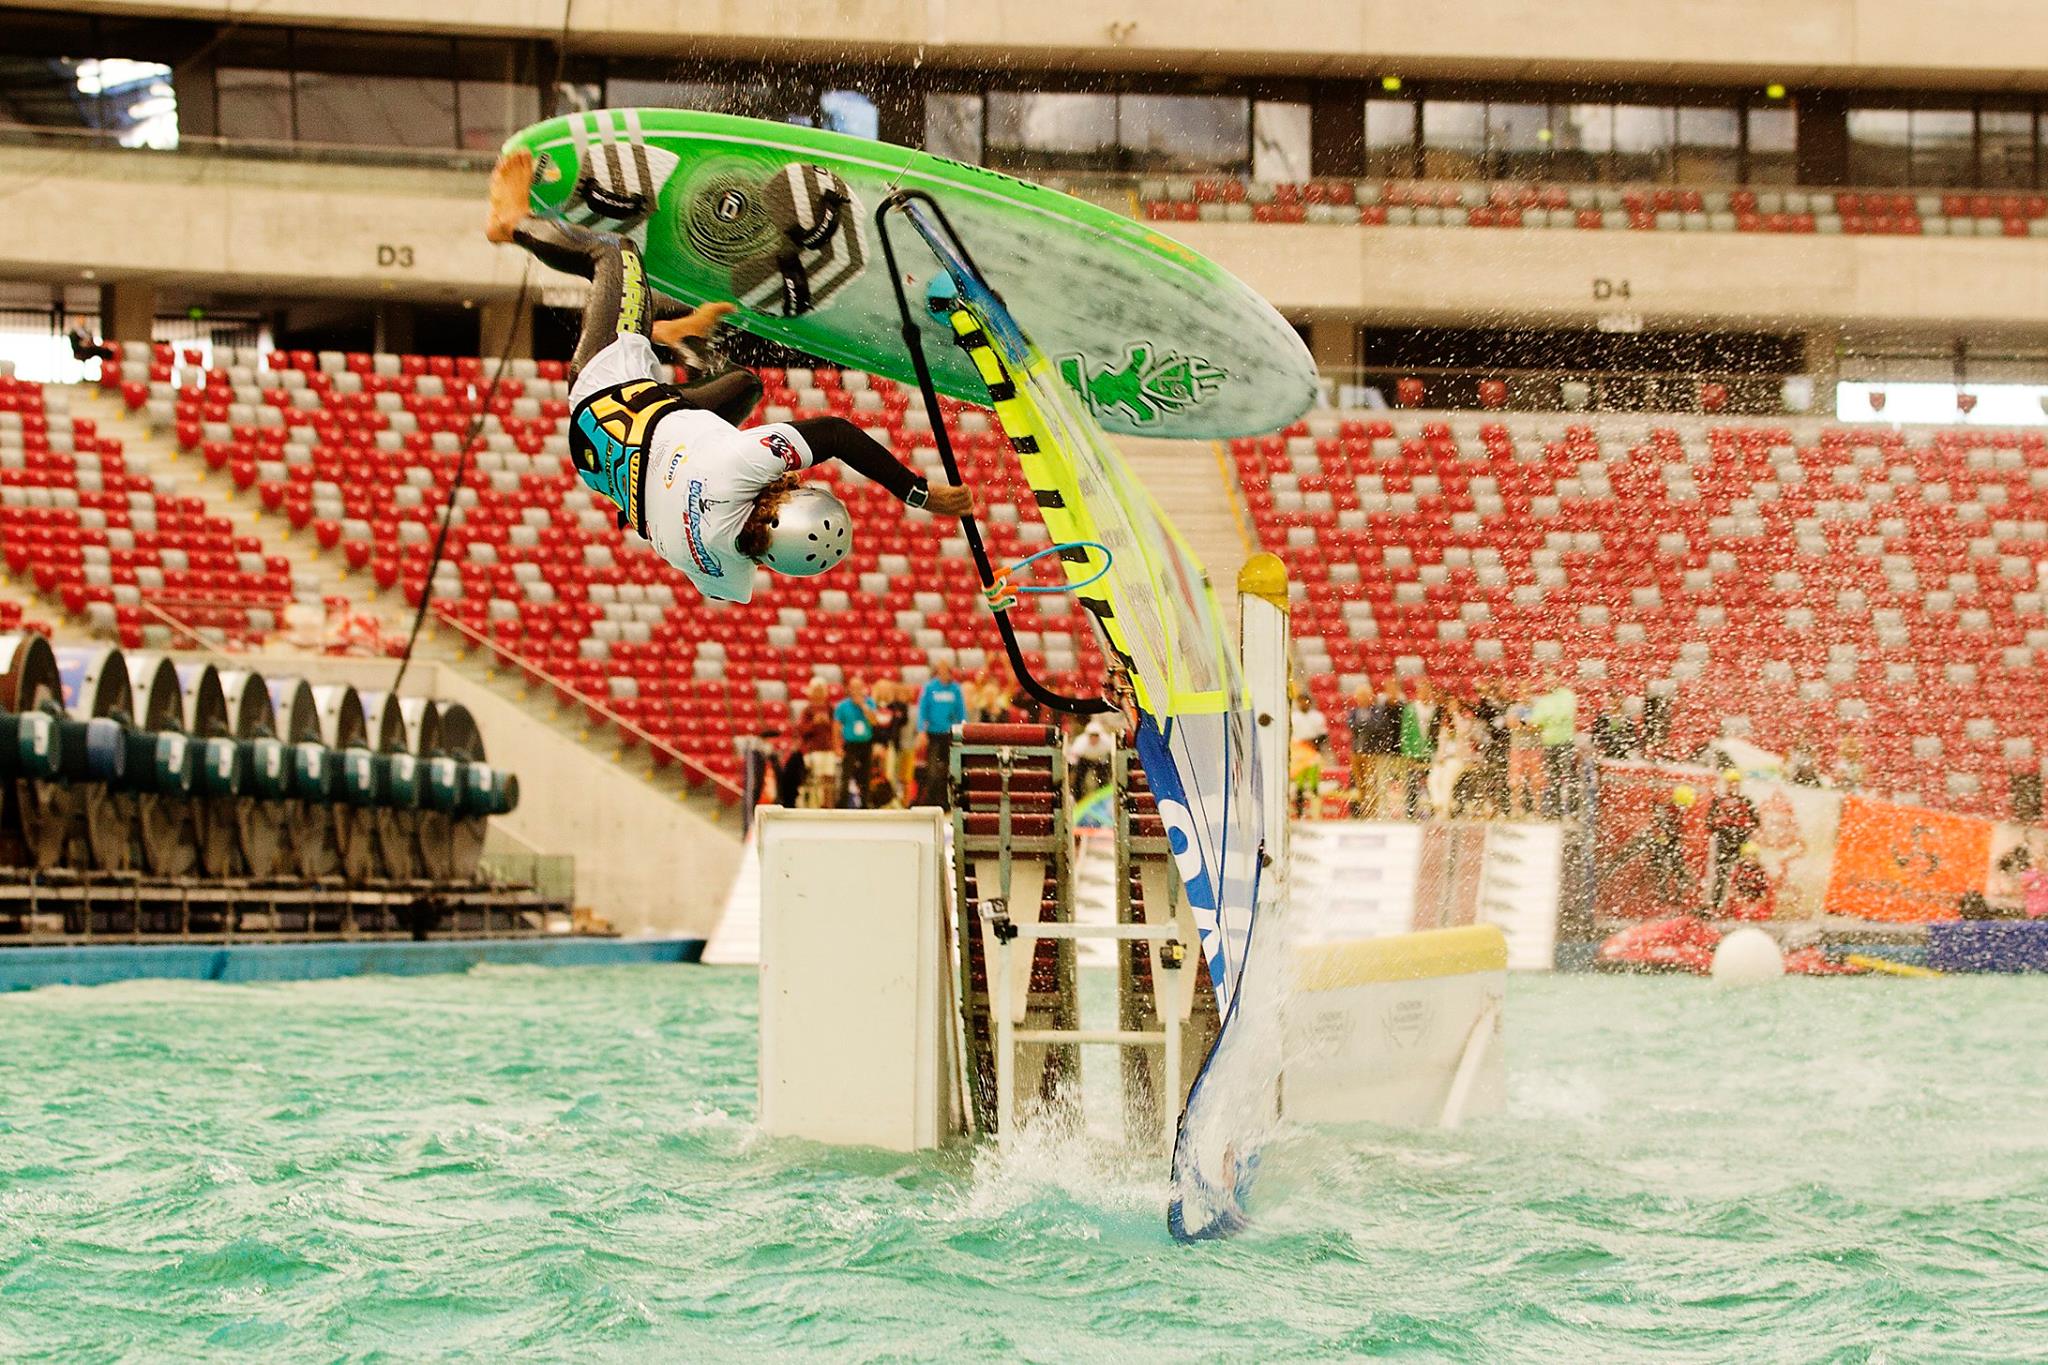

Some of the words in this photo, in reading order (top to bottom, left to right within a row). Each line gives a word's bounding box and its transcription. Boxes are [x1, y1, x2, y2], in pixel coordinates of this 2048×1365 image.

[377, 245, 414, 267] D3
[617, 250, 641, 333] CAMARO
[1593, 279, 1630, 300] D4
[669, 453, 684, 481] LOTTO
